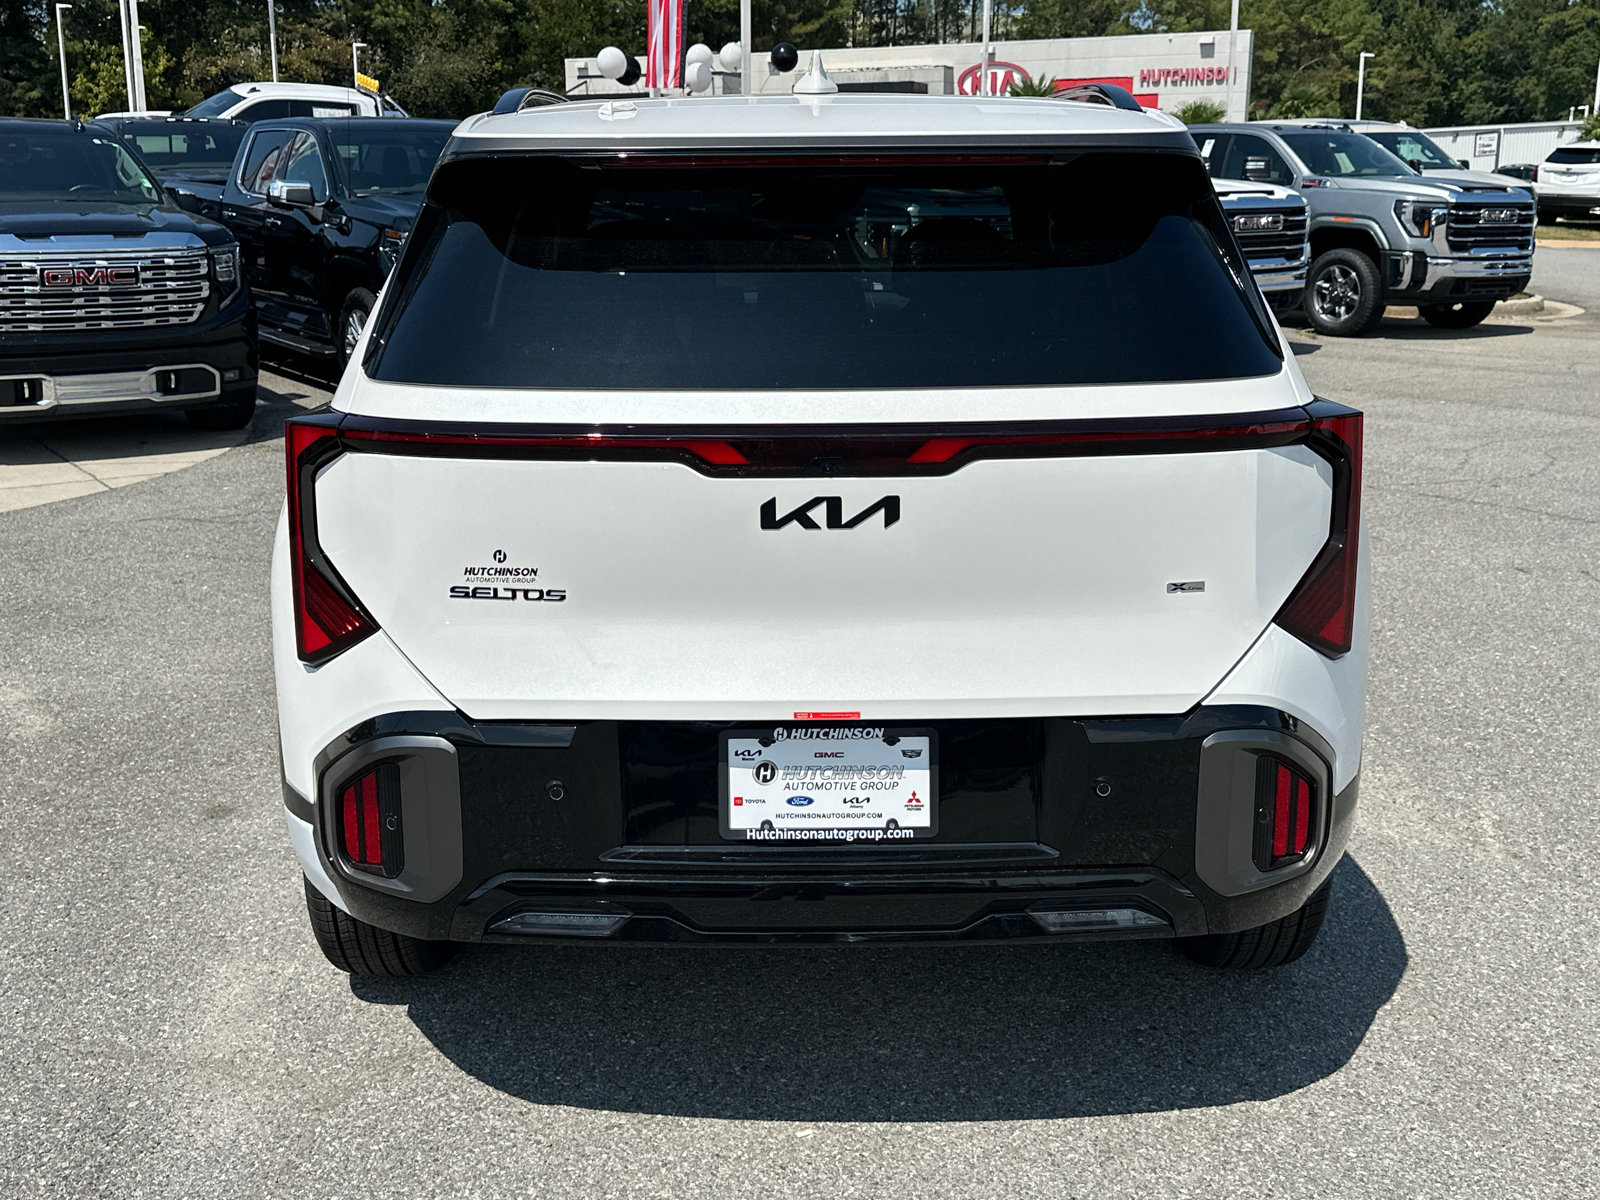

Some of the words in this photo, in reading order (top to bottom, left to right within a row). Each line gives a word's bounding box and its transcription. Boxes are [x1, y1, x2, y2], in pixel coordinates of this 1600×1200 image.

[44, 268, 136, 285] GMC
[760, 496, 900, 530] KIA
[464, 567, 538, 576] HUTCHINSON
[449, 586, 567, 602] SELTOS
[790, 728, 884, 740] HUTCHINSON
[781, 765, 905, 780] HUTCHINSON
[783, 782, 857, 791] AUTOMOTIVE
[859, 781, 899, 791] GROUP
[791, 797, 809, 805] Ford
[746, 828, 914, 841] Hutchinsonautogroup.com
